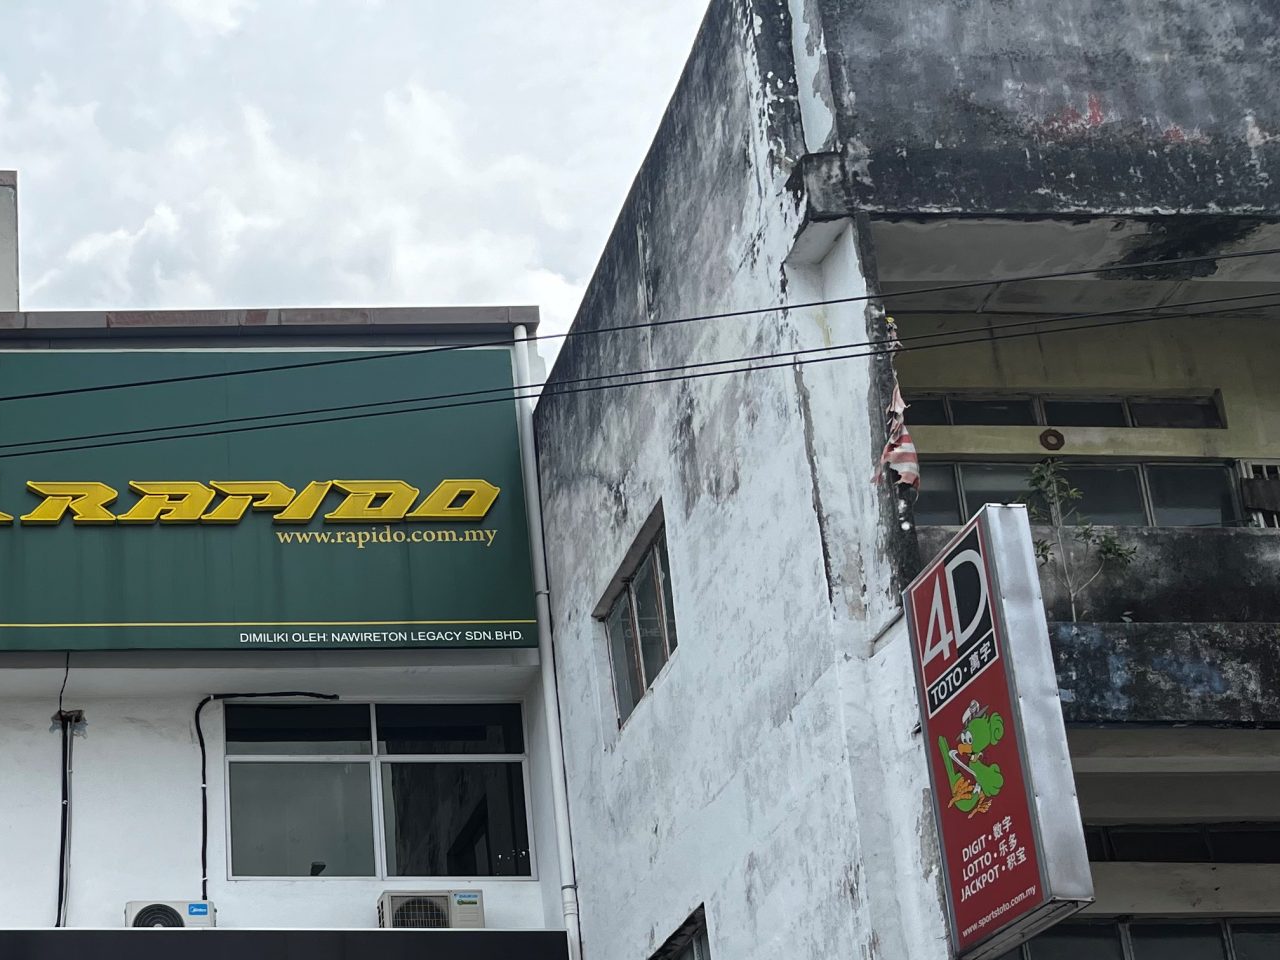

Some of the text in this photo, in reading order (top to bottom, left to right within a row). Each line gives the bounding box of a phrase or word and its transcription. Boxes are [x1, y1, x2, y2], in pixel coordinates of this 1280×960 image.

[20, 479, 501, 524] RAPIDO
[275, 526, 498, 549] www.rapido.com.my
[921, 548, 988, 668] 4D
[240, 632, 289, 643] DIMILIKI
[331, 631, 408, 642] NAWIRETON
[411, 631, 462, 642] LEGACY
[931, 667, 962, 706] TOTO
[962, 834, 986, 862] DIGIT
[962, 852, 992, 881] LOTTO
[961, 865, 1000, 902] JACKPOT
[962, 885, 1036, 937] www.sportstoto.com.my
